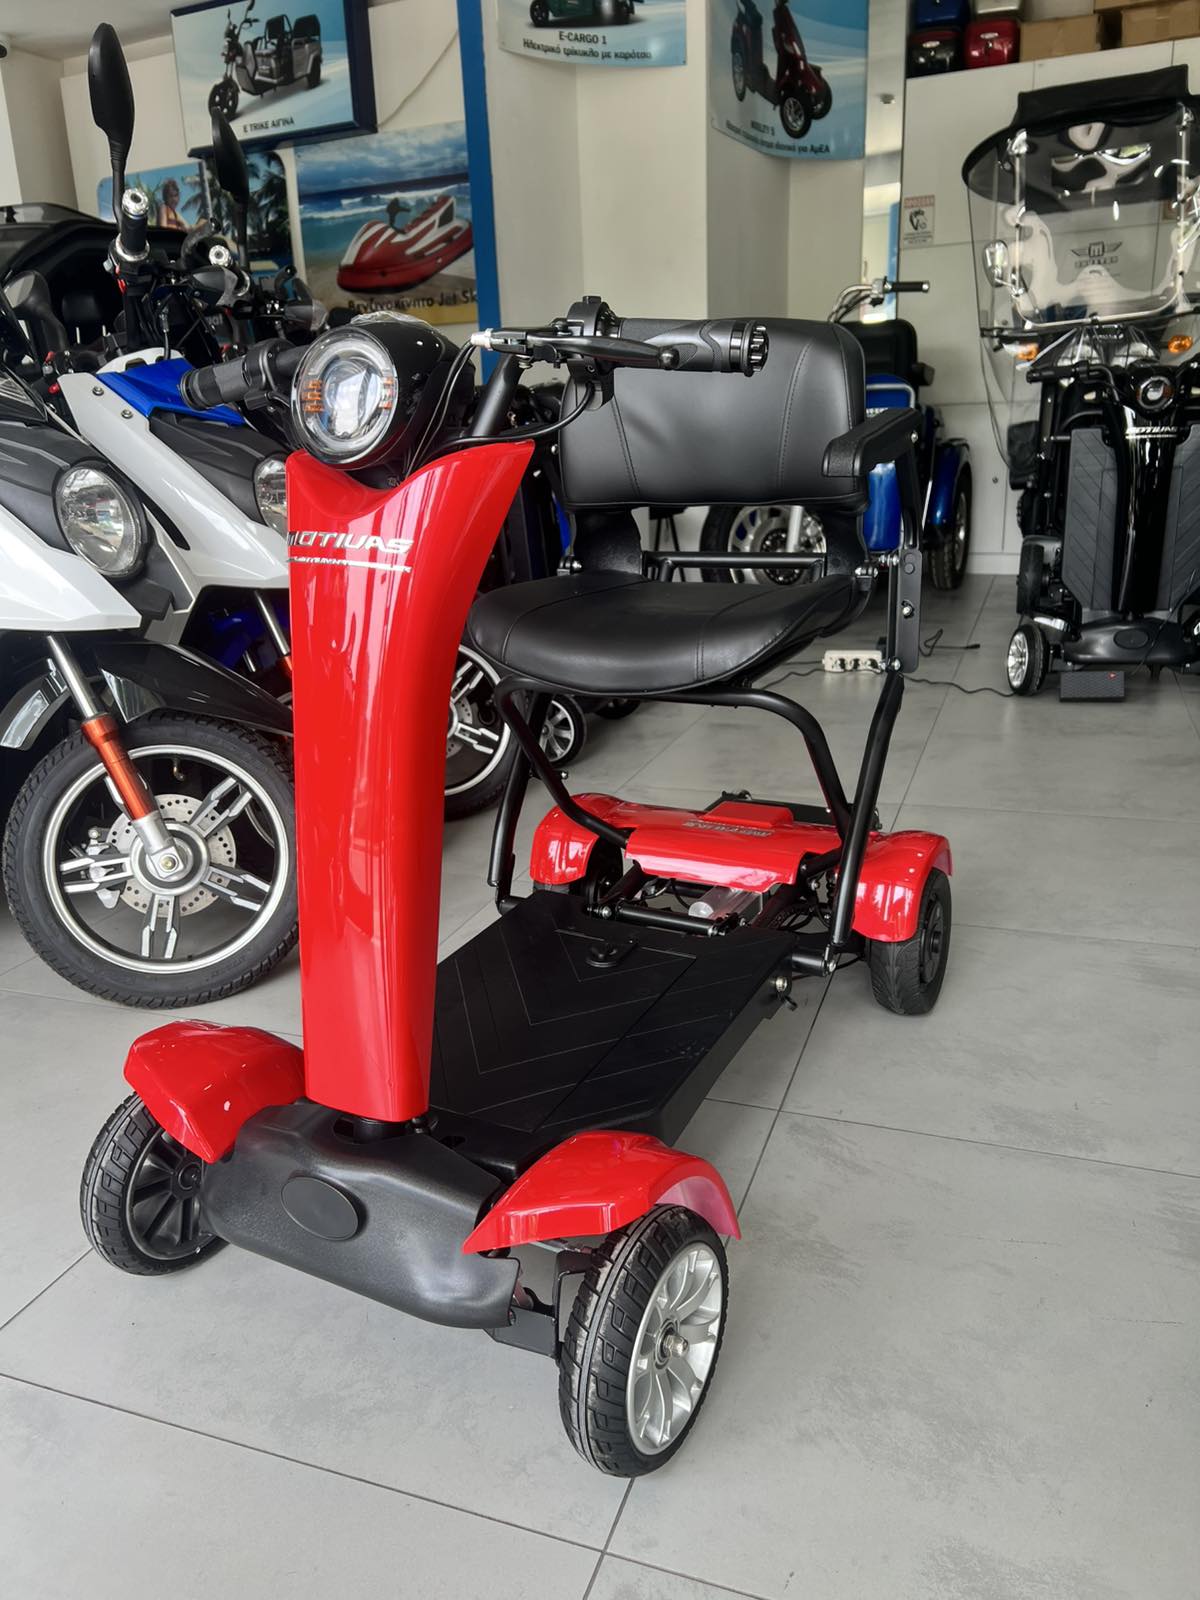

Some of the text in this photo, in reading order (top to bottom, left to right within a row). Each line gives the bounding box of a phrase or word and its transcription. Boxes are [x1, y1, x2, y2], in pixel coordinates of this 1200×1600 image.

[558, 31, 607, 45] E-CARGO 1
[601, 51, 612, 60] με
[462, 288, 479, 304] Sk
